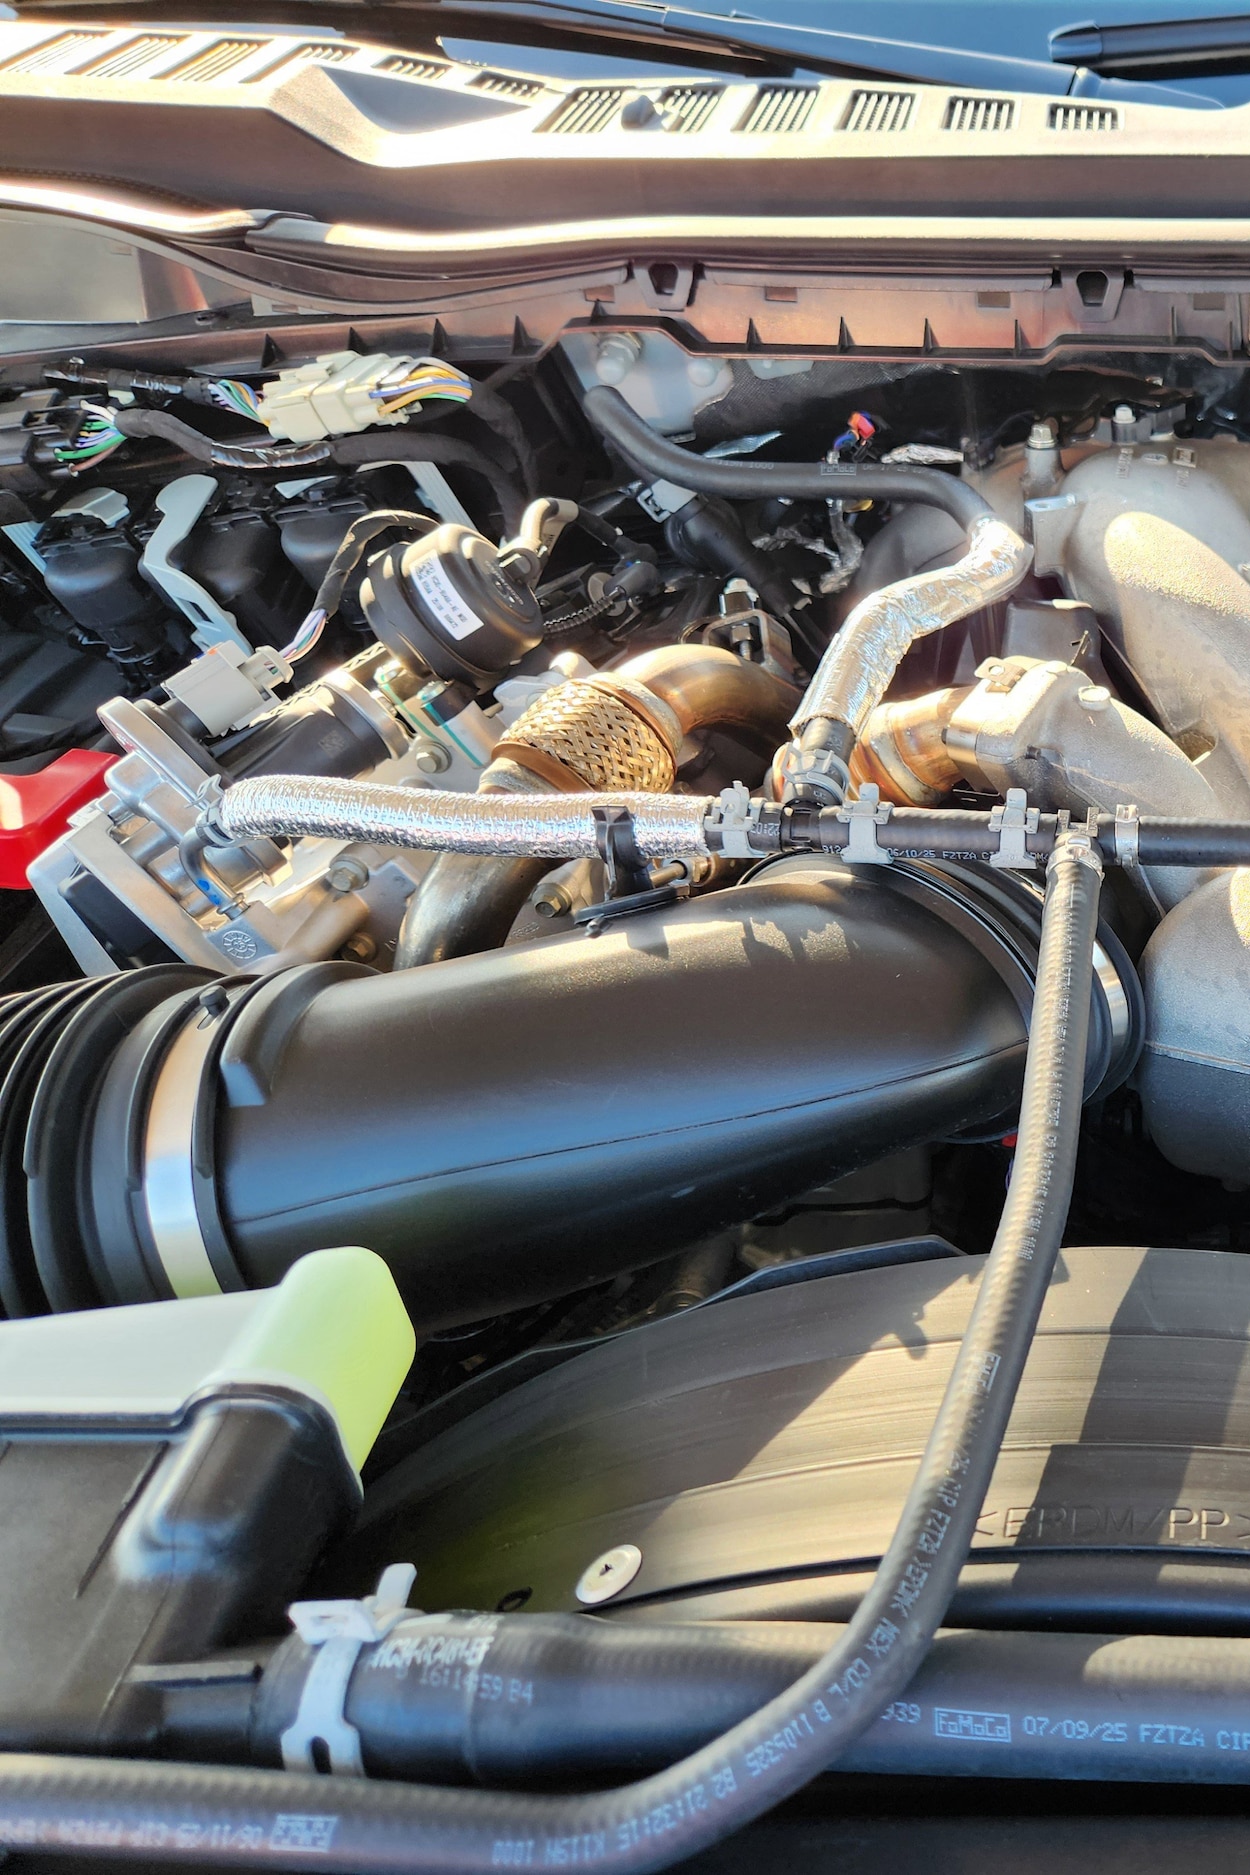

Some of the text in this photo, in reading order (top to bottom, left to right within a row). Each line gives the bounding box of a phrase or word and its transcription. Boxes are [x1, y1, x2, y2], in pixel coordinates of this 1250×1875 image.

[942, 850, 977, 860] FZTZA
[865, 1618, 901, 1658] MEX
[935, 1708, 1010, 1742] FoMoCo
[1021, 1714, 1129, 1743] 07/09/25
[1139, 1723, 1205, 1749] FZTZA
